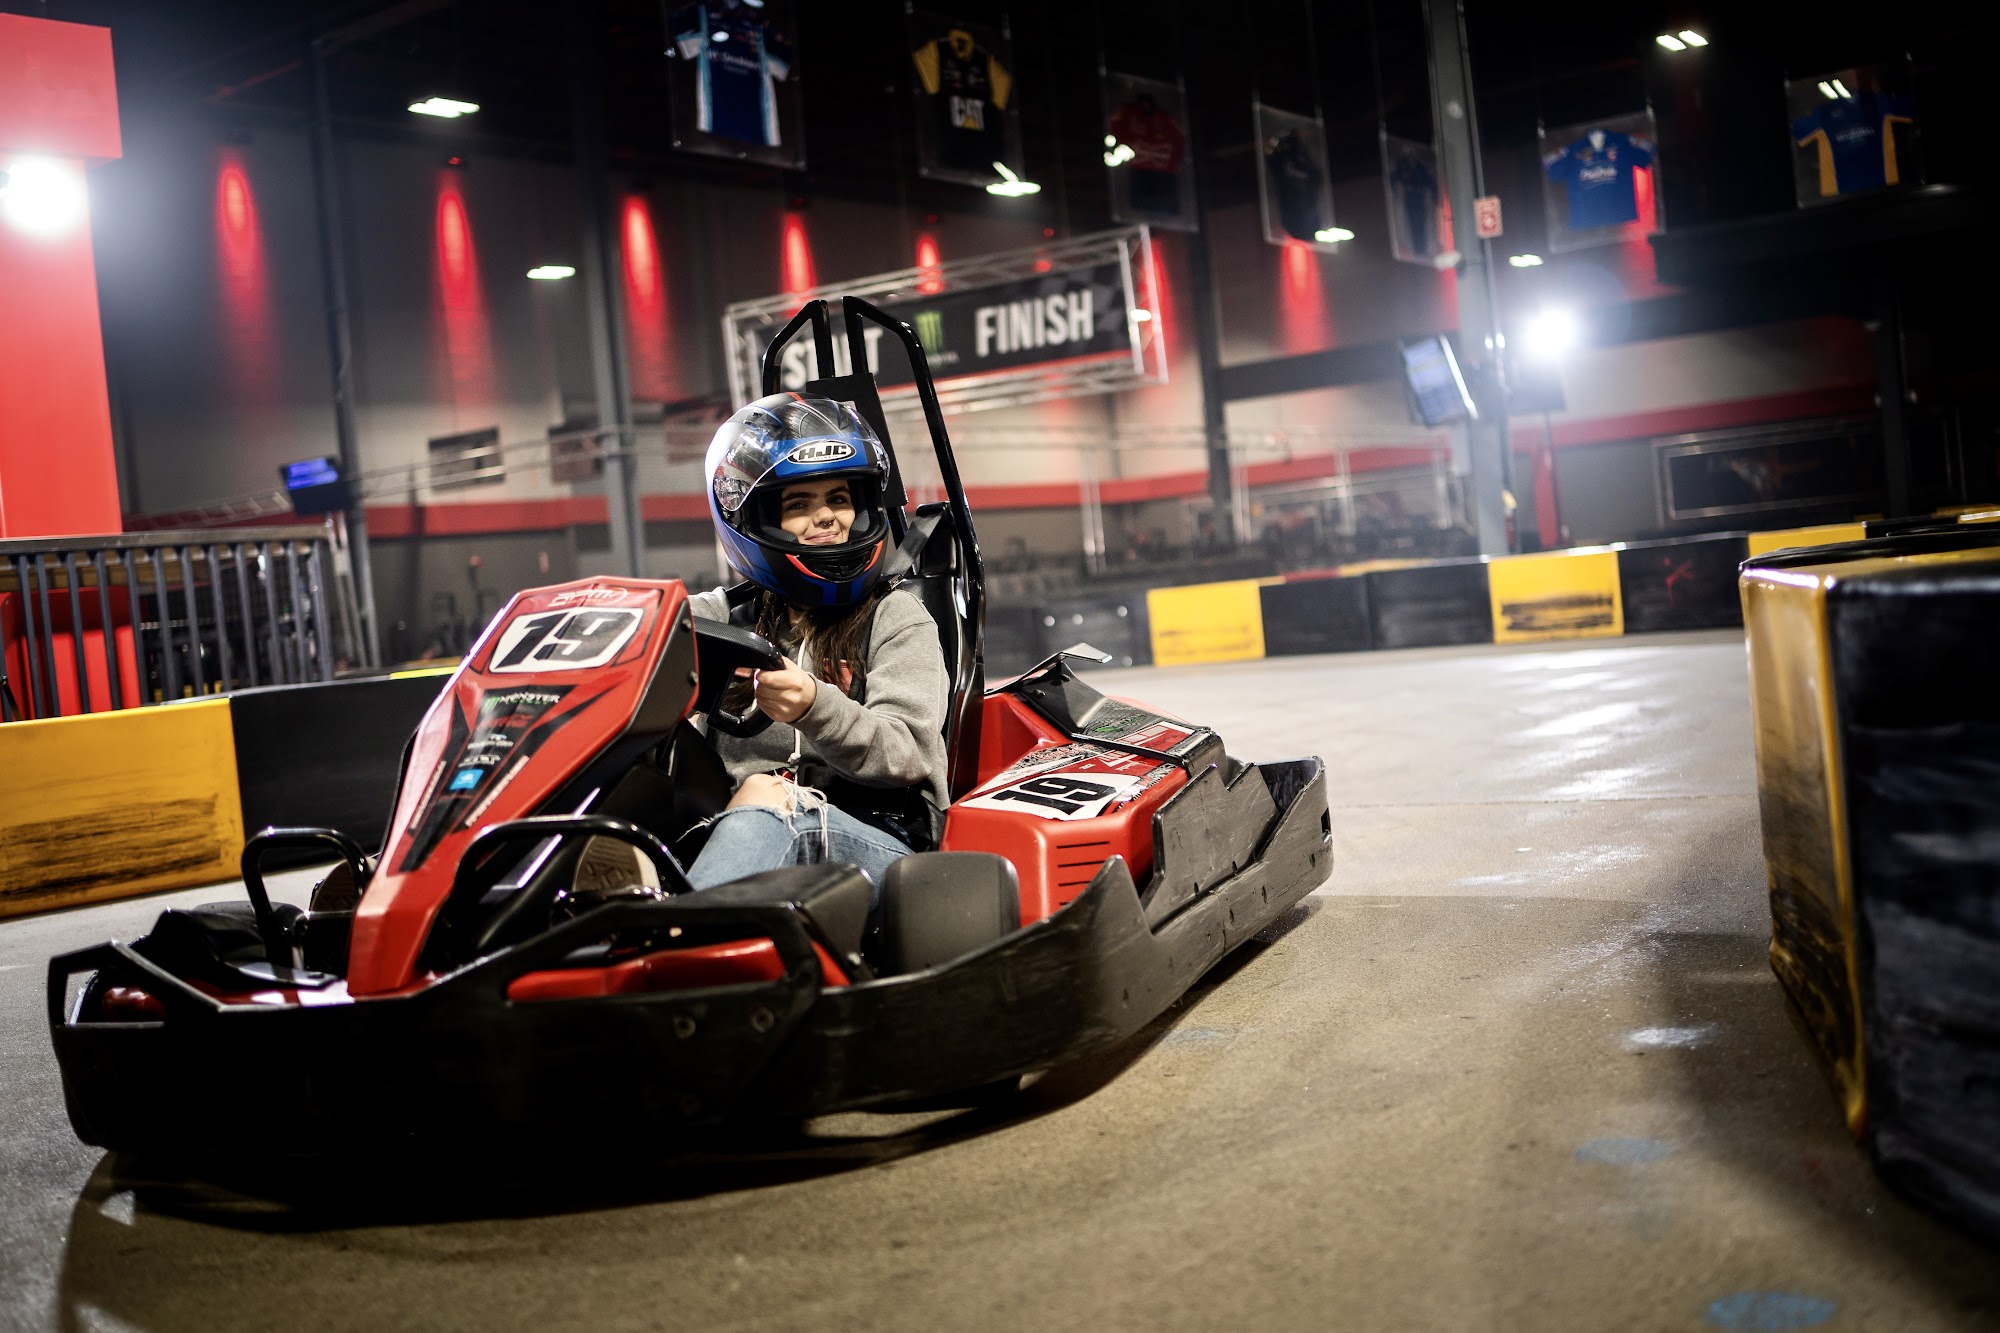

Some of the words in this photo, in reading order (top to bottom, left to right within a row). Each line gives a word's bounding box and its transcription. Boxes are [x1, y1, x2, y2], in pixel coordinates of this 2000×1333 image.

[950, 95, 985, 131] CAT
[974, 289, 1095, 358] FINISH
[798, 445, 847, 460] HJC
[494, 611, 637, 670] 19
[990, 777, 1117, 815] 19
